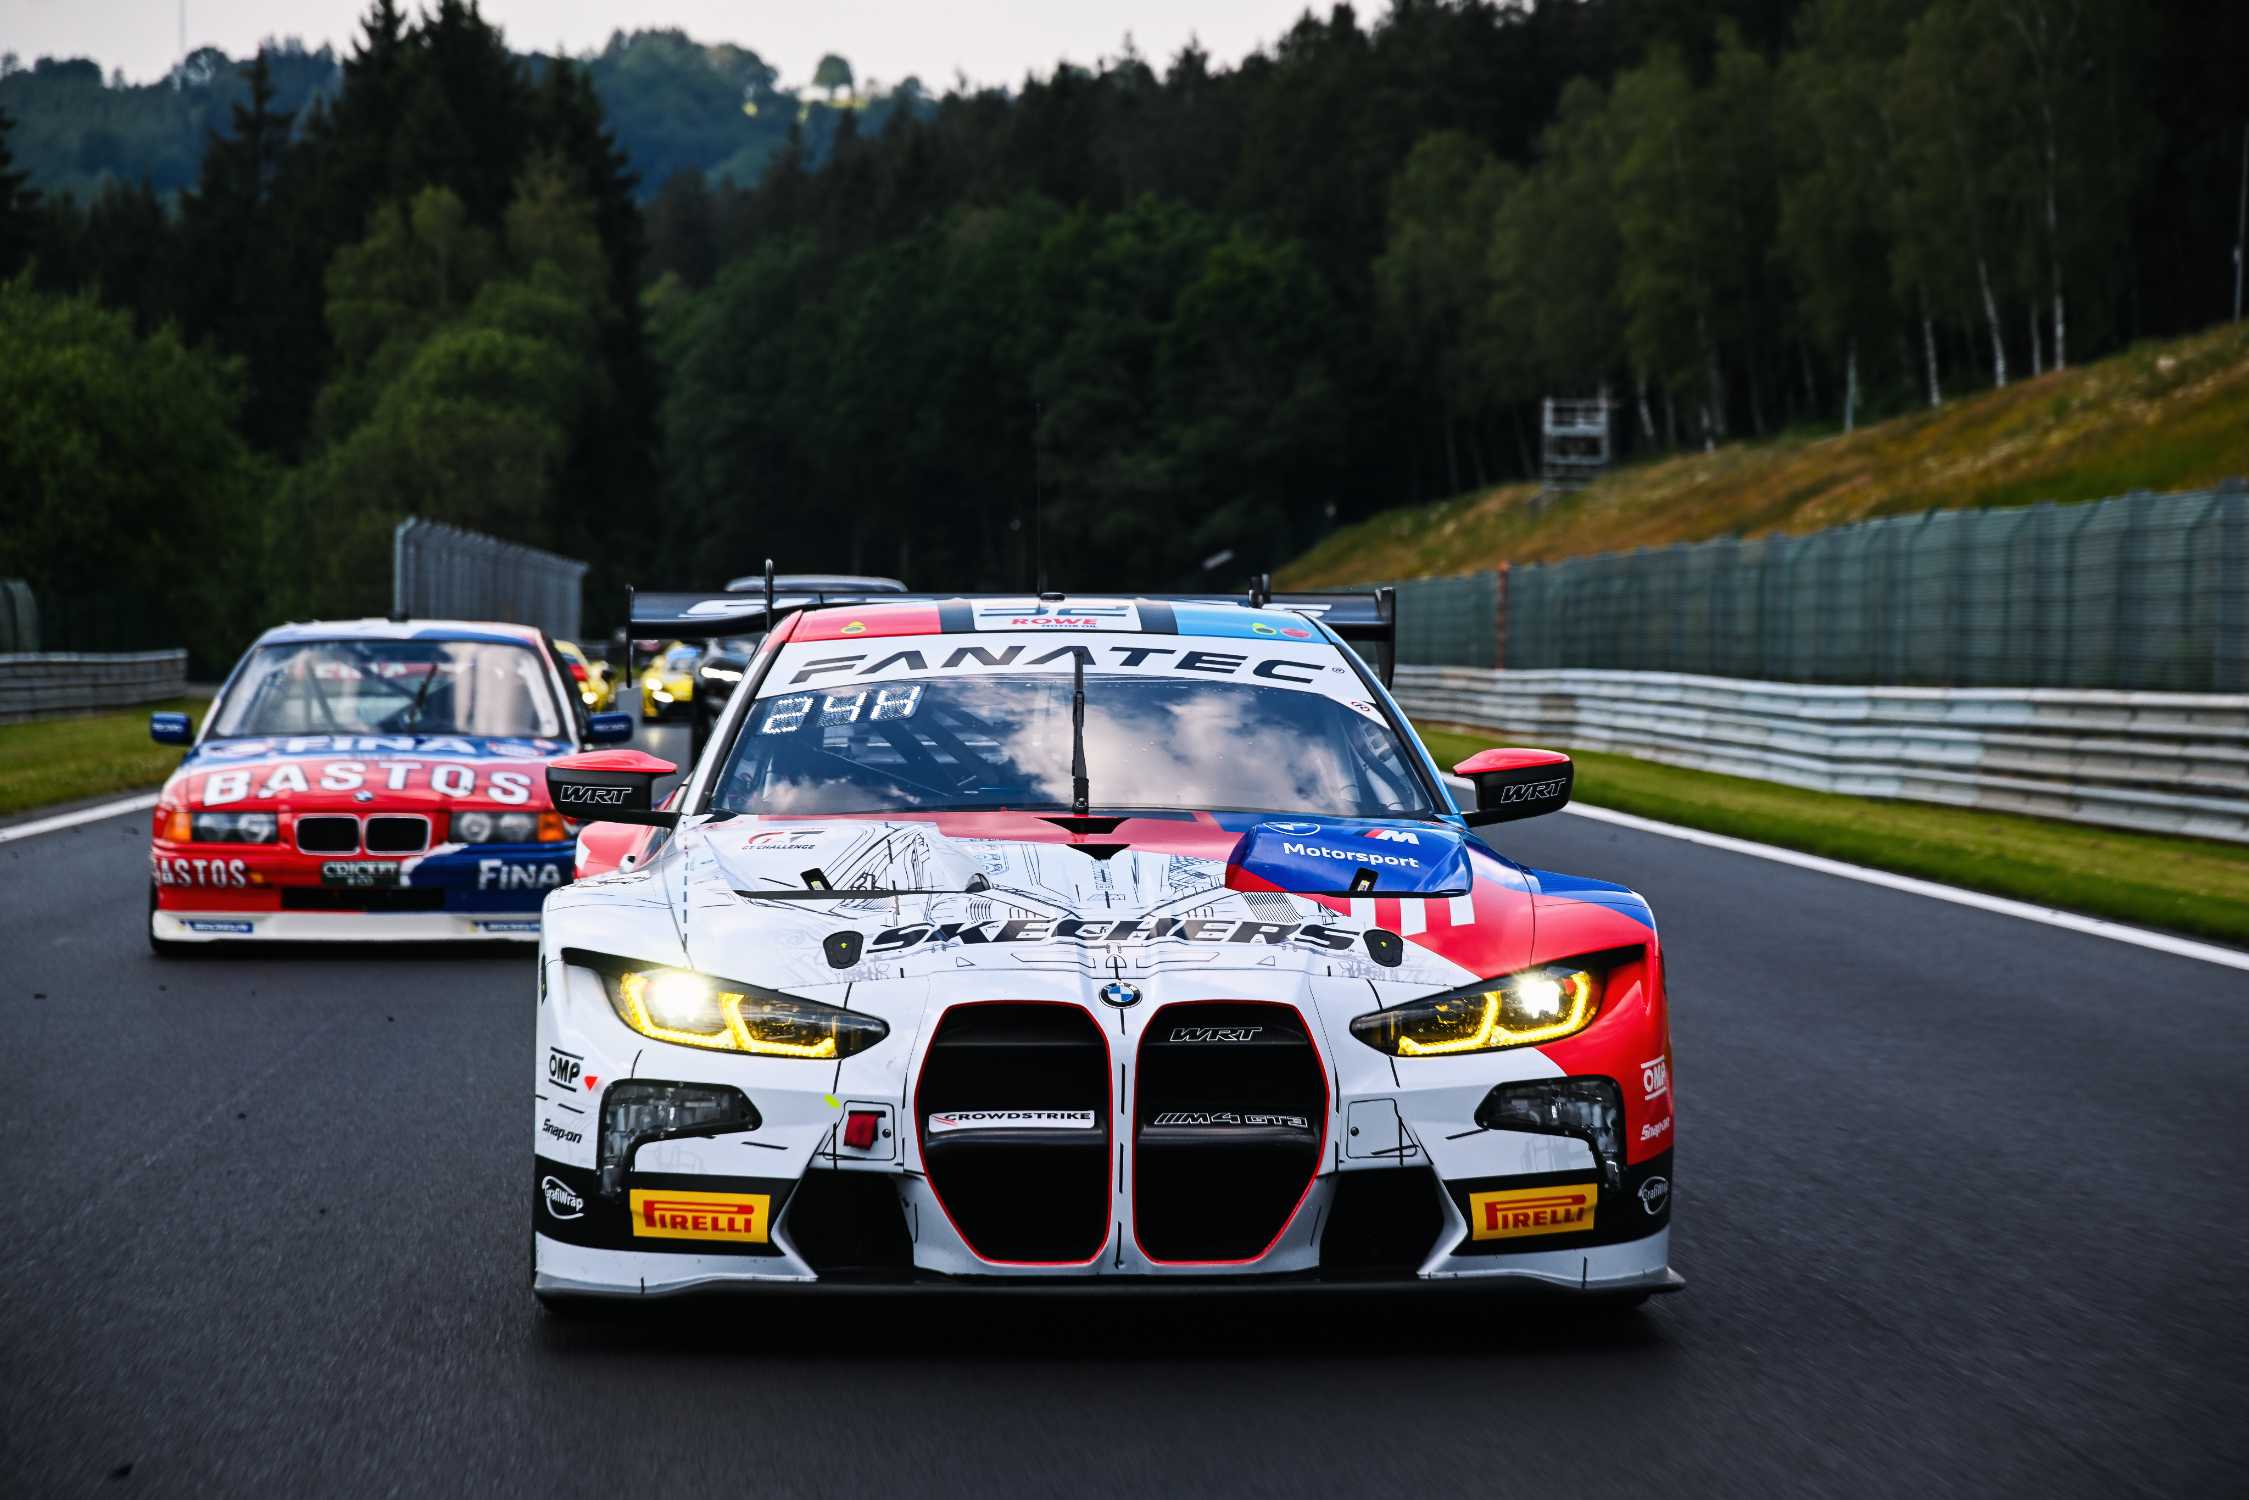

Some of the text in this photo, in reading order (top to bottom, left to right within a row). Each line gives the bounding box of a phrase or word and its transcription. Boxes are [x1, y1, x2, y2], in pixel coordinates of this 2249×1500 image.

[788, 645, 1325, 685] FANATEC
[286, 736, 478, 755] FINA
[203, 760, 533, 806] BASTOS
[560, 785, 632, 804] WRT
[1500, 777, 1567, 803] WRT
[1283, 842, 1420, 868] Motorsport
[478, 859, 561, 890] FINA
[866, 918, 1360, 954] SKECHERS
[1169, 1026, 1262, 1042] WRT
[549, 1054, 581, 1085] OMP
[946, 1112, 1091, 1121] CROWDSTRIKE
[1245, 1114, 1308, 1129] GT3
[542, 1119, 583, 1144] Snap-on
[643, 1200, 755, 1233] PIRELLI
[1484, 1194, 1587, 1231] PIRELLI
